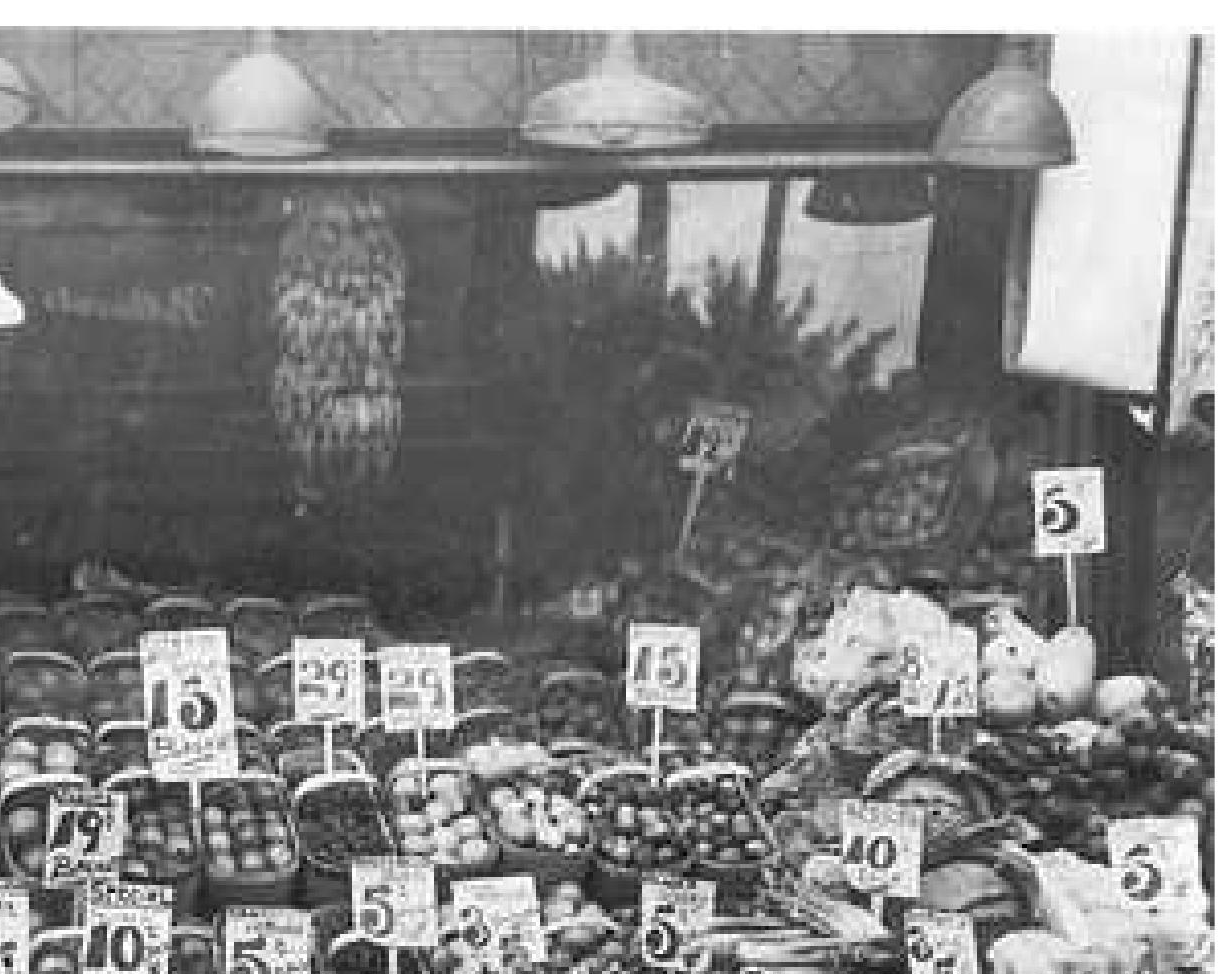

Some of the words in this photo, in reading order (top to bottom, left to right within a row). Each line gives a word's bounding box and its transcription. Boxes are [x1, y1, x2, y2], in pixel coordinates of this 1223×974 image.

[1041, 484, 1080, 536] 5
[298, 659, 349, 699] 29
[388, 667, 447, 711] 29
[634, 645, 689, 690] 15
[151, 674, 218, 732] 15
[50, 810, 102, 854] 19
[842, 835, 897, 870] 10
[1121, 843, 1164, 903] 5
[361, 884, 393, 937] 5
[644, 904, 680, 962] 5
[86, 921, 143, 970] 10
